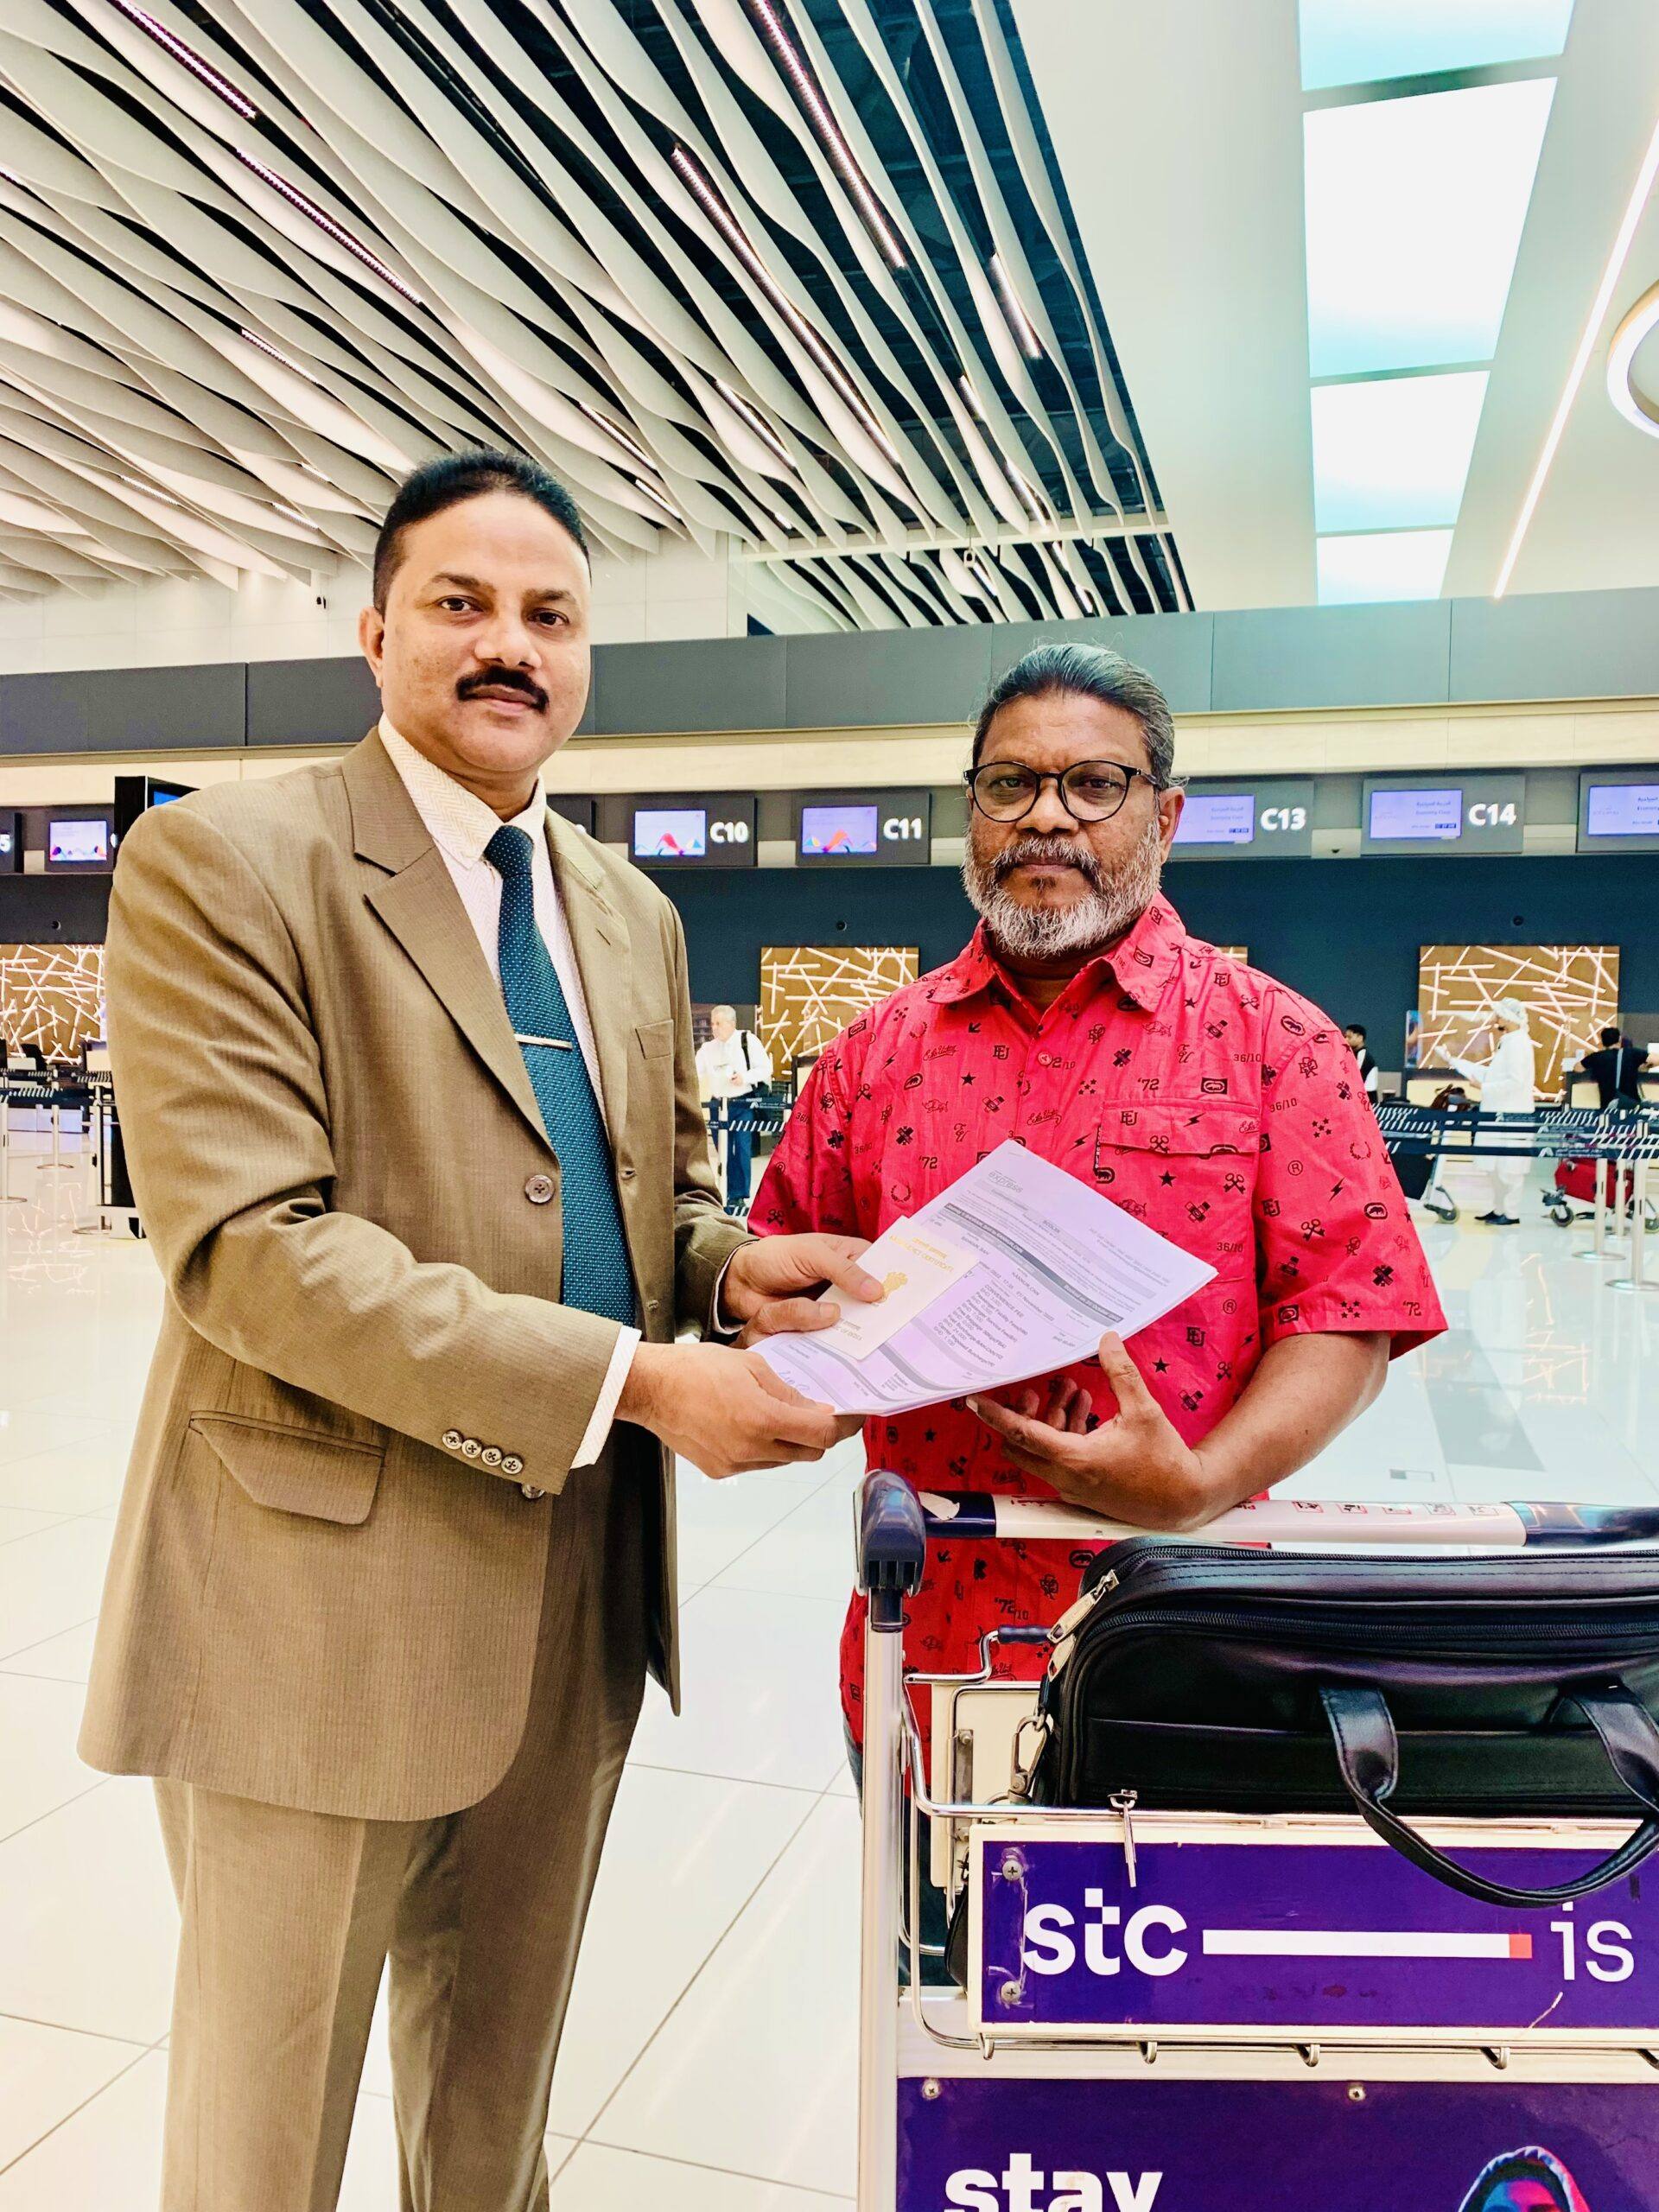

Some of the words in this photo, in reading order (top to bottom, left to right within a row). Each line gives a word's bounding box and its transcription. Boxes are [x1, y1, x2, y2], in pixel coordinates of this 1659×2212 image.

[1260, 807, 1306, 831] C13
[1469, 803, 1516, 826] C14
[709, 821, 749, 843] C10
[883, 817, 922, 840] C11
[1024, 1887, 1188, 1976] stc
[1550, 1903, 1635, 1981] is
[944, 2152, 1163, 2212] stay
